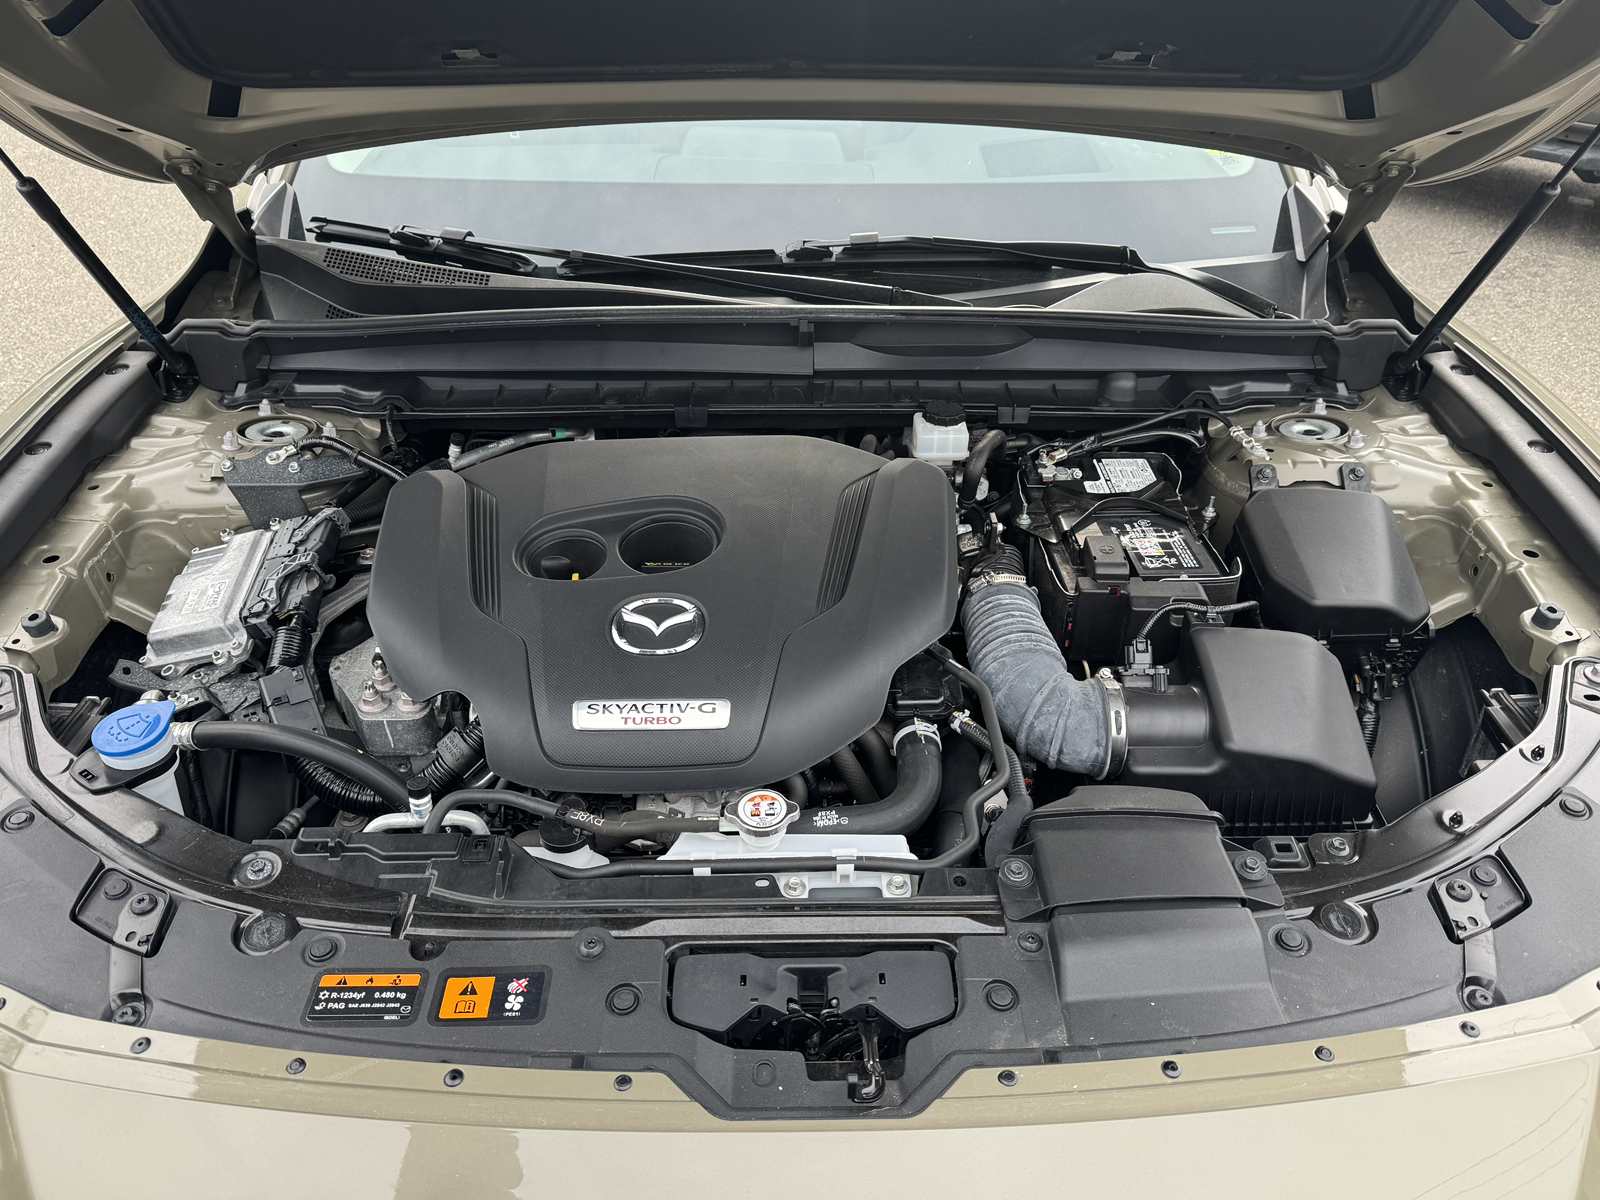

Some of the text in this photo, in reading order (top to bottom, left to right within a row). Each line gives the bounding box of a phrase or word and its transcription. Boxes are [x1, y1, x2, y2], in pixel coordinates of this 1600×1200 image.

[586, 702, 717, 715] SKYACTIV-G
[620, 716, 682, 726] TURBO
[330, 991, 407, 1000] R-1234yf 0.480 kg
[327, 1002, 346, 1010] PAG
